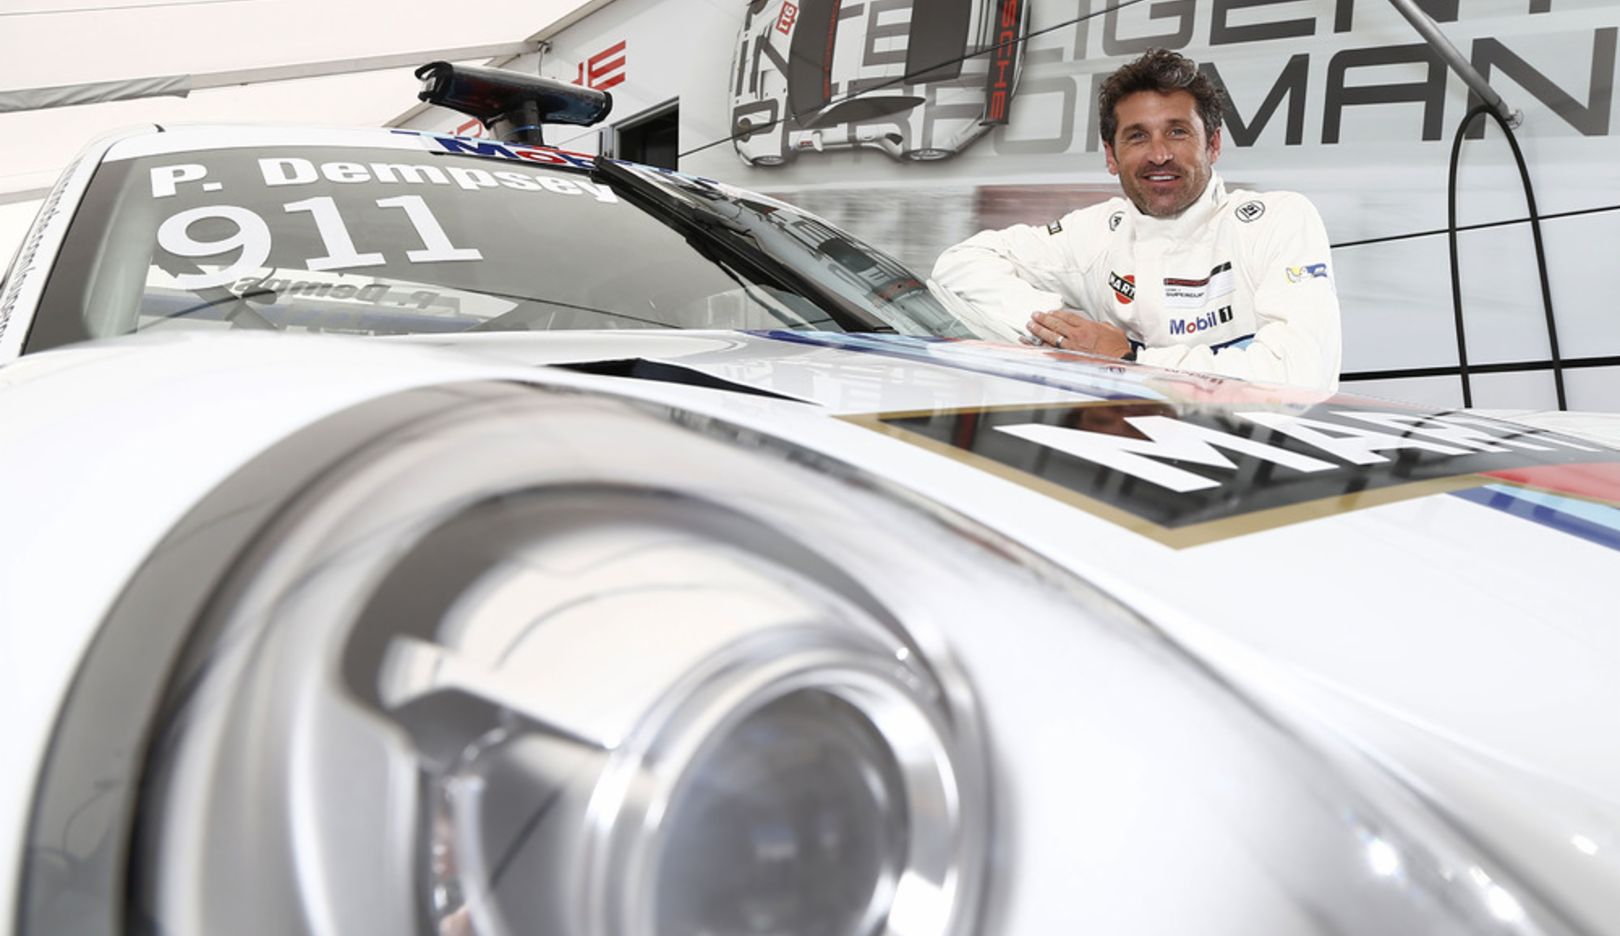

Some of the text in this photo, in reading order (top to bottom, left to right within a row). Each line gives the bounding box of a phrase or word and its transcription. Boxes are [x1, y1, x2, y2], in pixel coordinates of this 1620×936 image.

[149, 157, 619, 203] P. Dempsey
[156, 195, 484, 290] 911
[1169, 306, 1233, 335] Mobil 1
